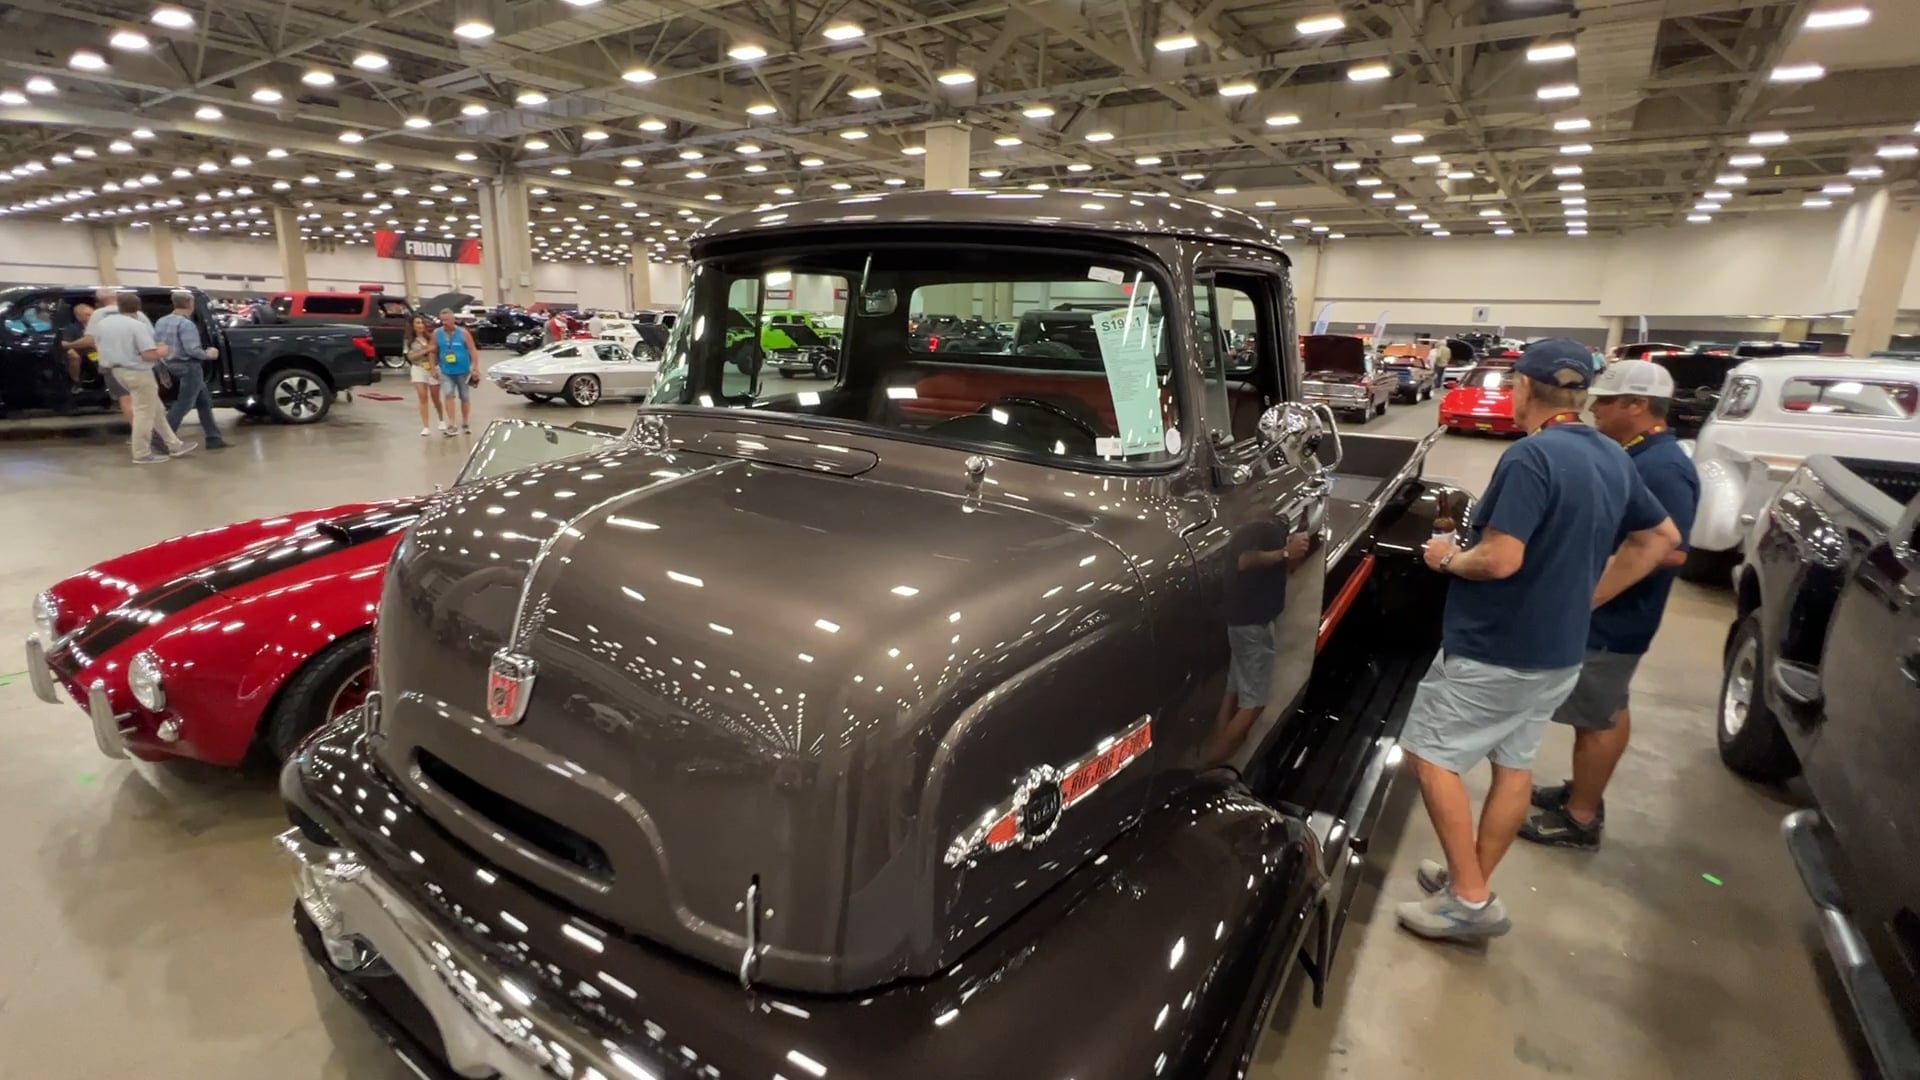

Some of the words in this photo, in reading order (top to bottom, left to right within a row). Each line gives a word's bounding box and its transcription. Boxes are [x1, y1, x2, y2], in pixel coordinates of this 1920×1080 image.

[405, 240, 452, 257] FRIDAY
[1101, 316, 1141, 331] S19.1
[1070, 769, 1090, 795] BIG
